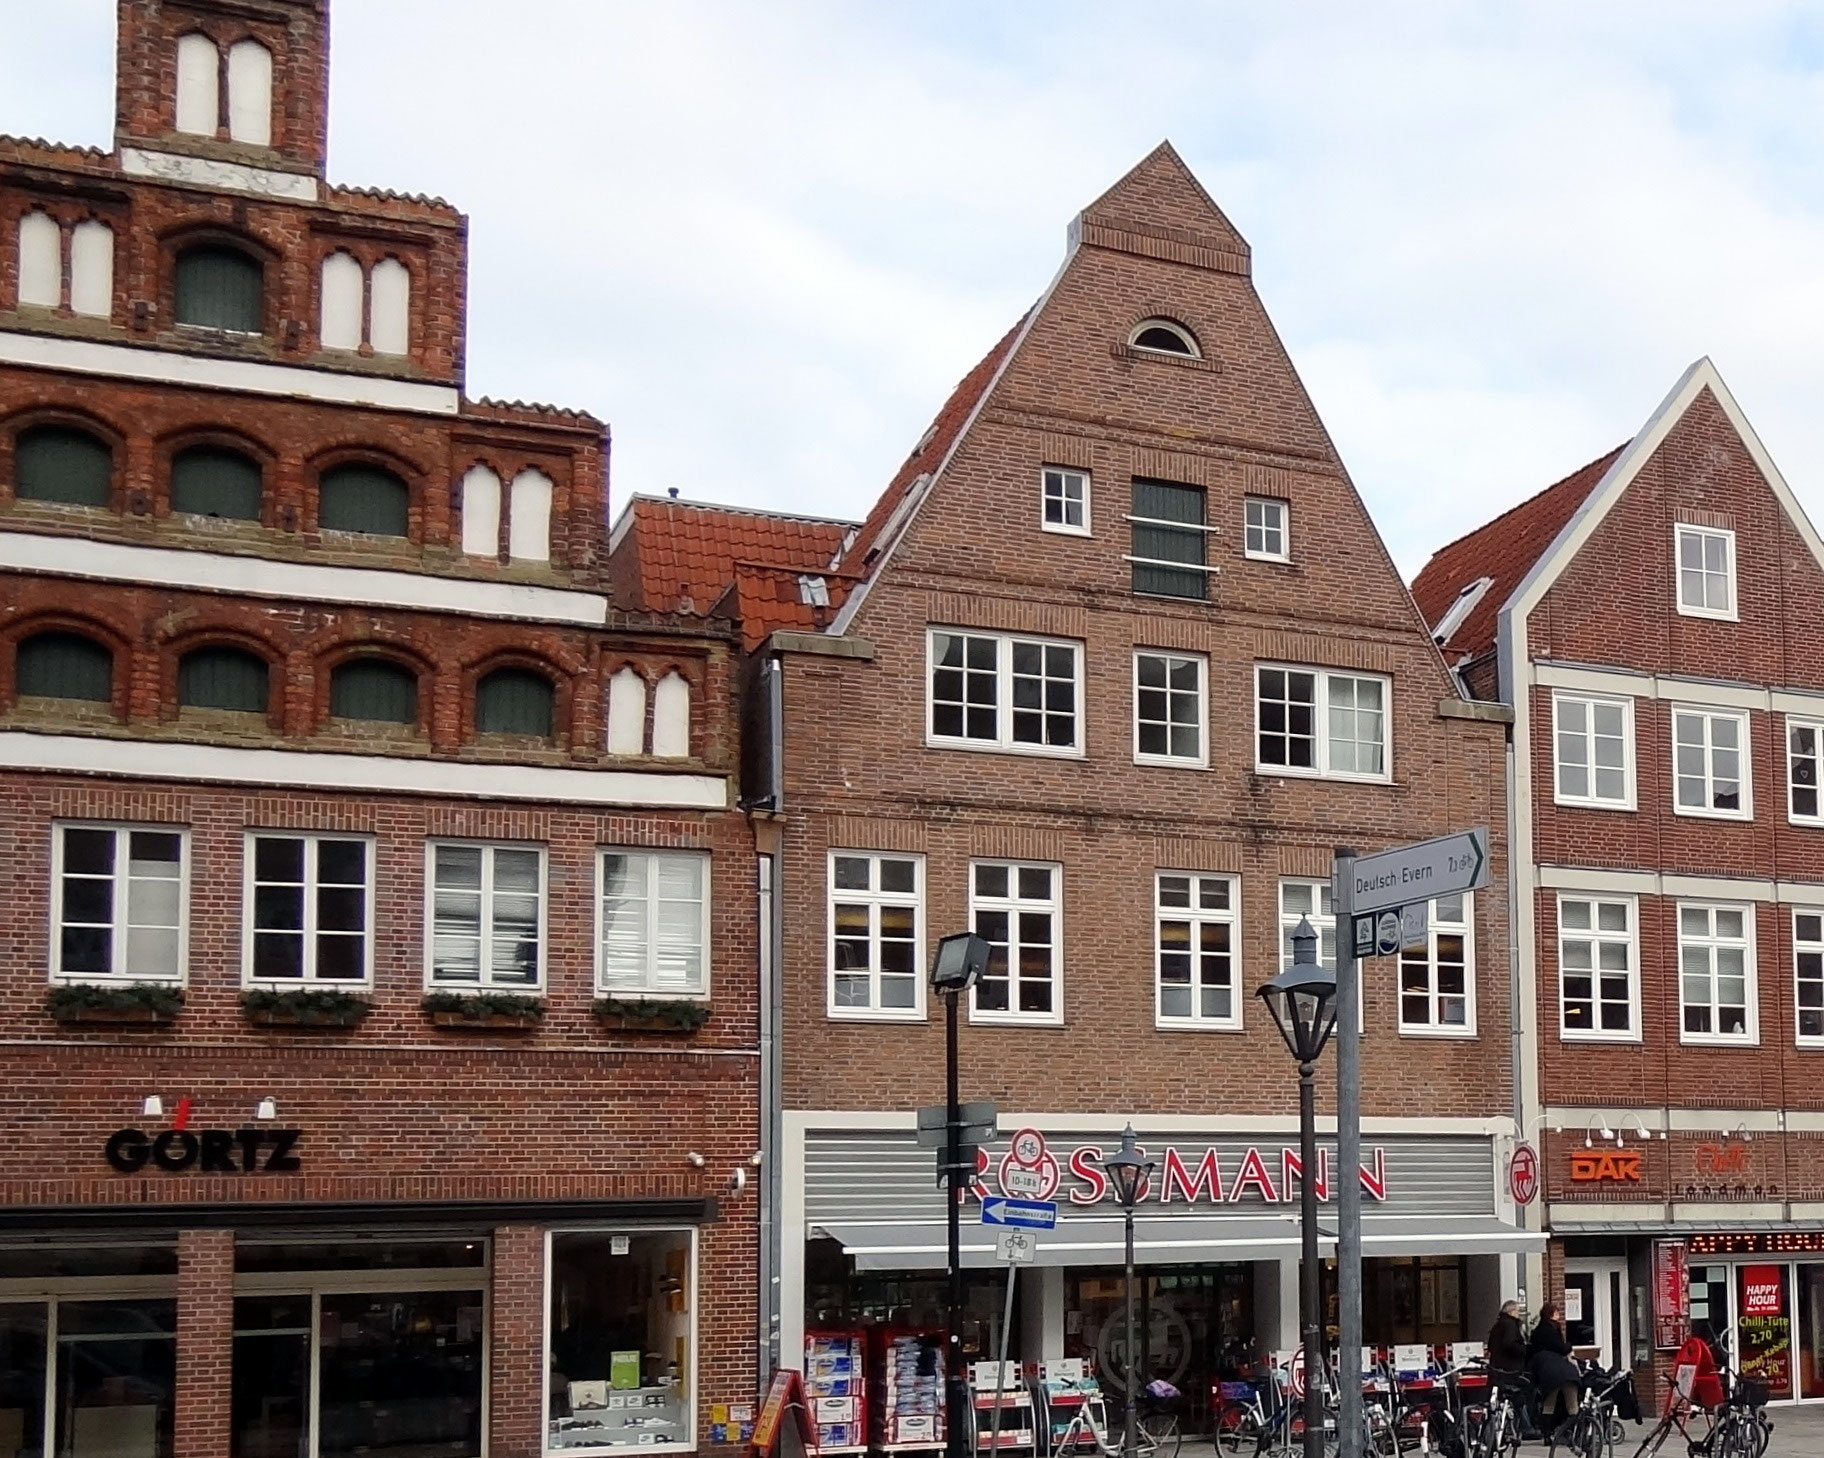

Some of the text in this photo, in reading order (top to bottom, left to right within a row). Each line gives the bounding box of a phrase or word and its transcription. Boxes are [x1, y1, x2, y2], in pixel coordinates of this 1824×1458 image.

[1356, 866, 1433, 893] Deutsch-Evern
[1571, 1152, 1640, 1181] DAK
[1746, 1284, 1778, 1295] HAPPY
[1749, 1295, 1776, 1305] HOUR
